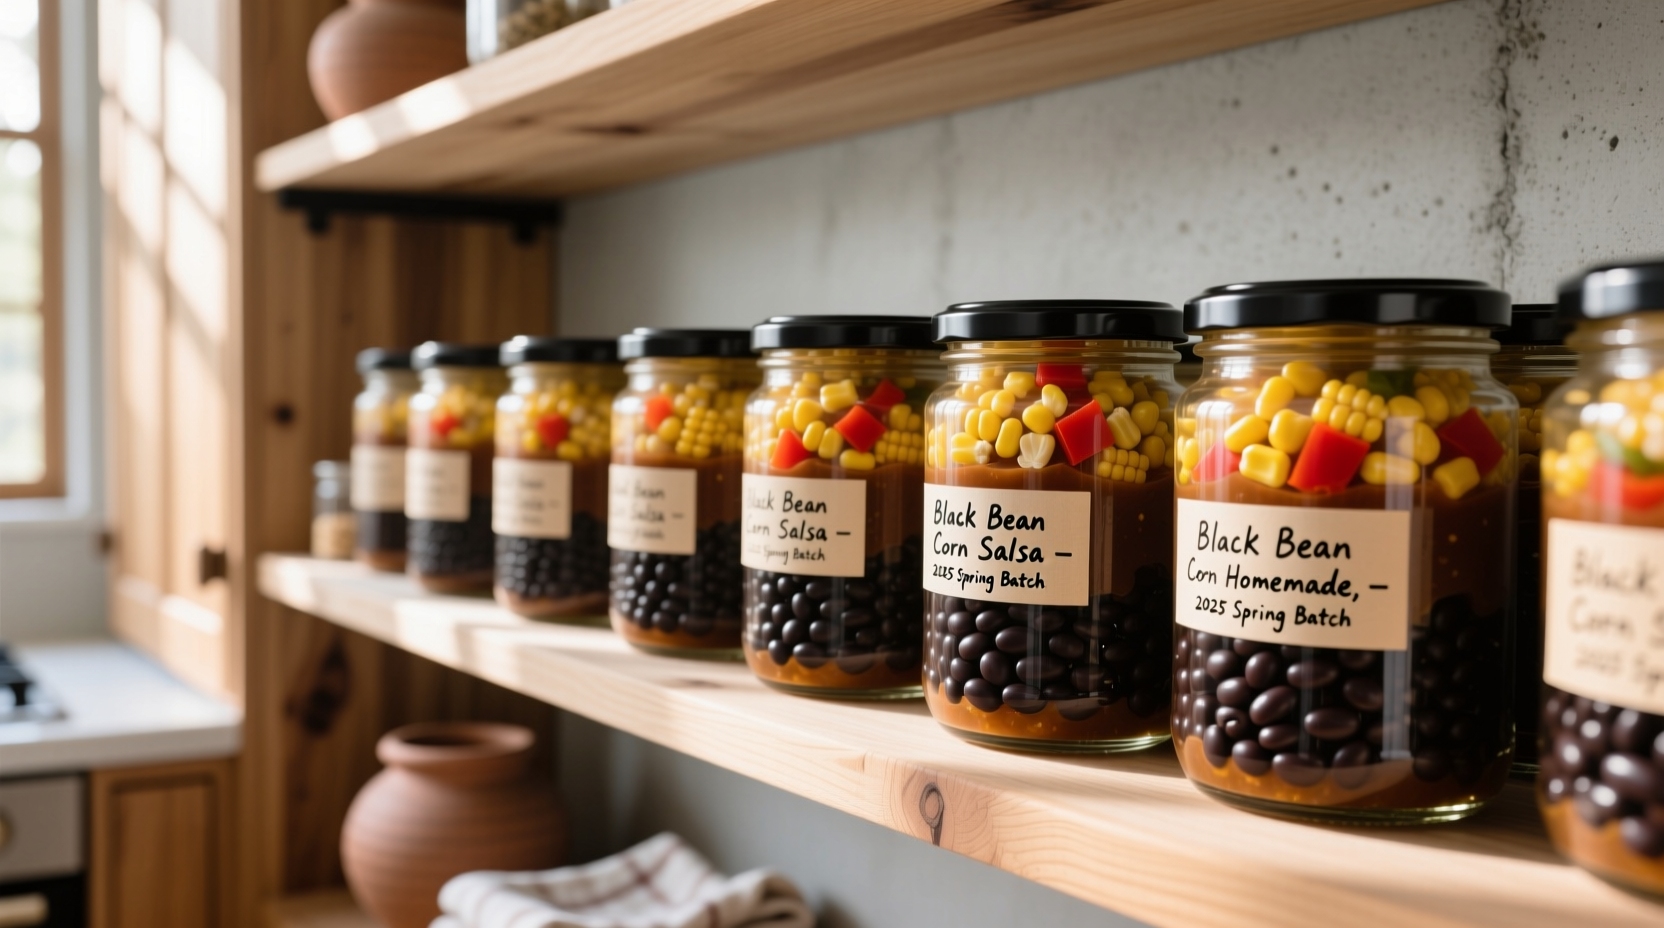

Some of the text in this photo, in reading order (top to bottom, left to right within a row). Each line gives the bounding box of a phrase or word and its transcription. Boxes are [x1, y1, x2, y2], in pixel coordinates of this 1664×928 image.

[782, 490, 828, 514] Bean
[933, 499, 1045, 531] Black Bean
[777, 518, 828, 542] Salsa
[1197, 520, 1351, 560] Black Bean
[933, 531, 968, 557] Corn
[978, 535, 1044, 563] Salsa
[957, 567, 995, 594] Spring
[1000, 570, 1045, 589] Batch
[1187, 557, 1217, 585] Corn
[1225, 564, 1360, 602] Homemade,
[1195, 595, 1351, 633] 2025 Spring Batch
